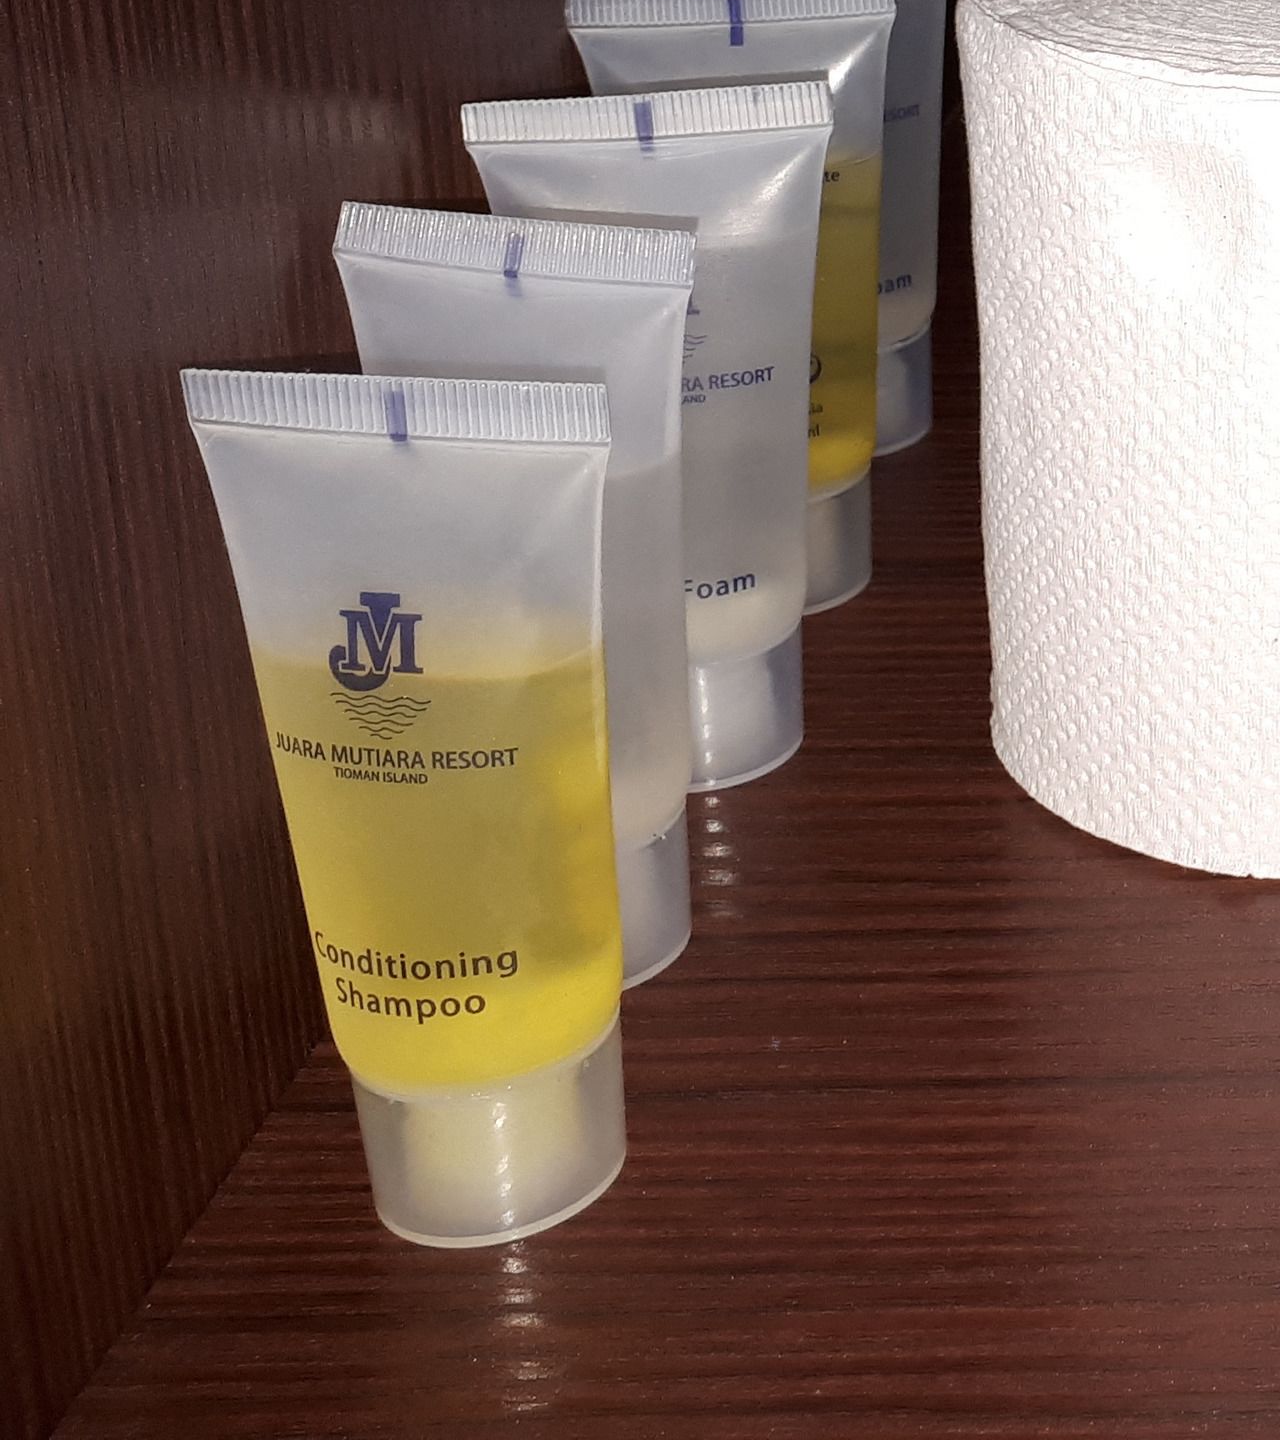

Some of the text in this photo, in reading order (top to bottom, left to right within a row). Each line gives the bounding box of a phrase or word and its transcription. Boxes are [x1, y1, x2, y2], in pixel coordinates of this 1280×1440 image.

[708, 366, 775, 390] RESORT
[276, 731, 519, 770] JUARA MUTIARA RESORT
[333, 766, 429, 785] TIOMAN ISLAND
[314, 930, 519, 981] Conditioning
[335, 976, 487, 1025] Shampoo
